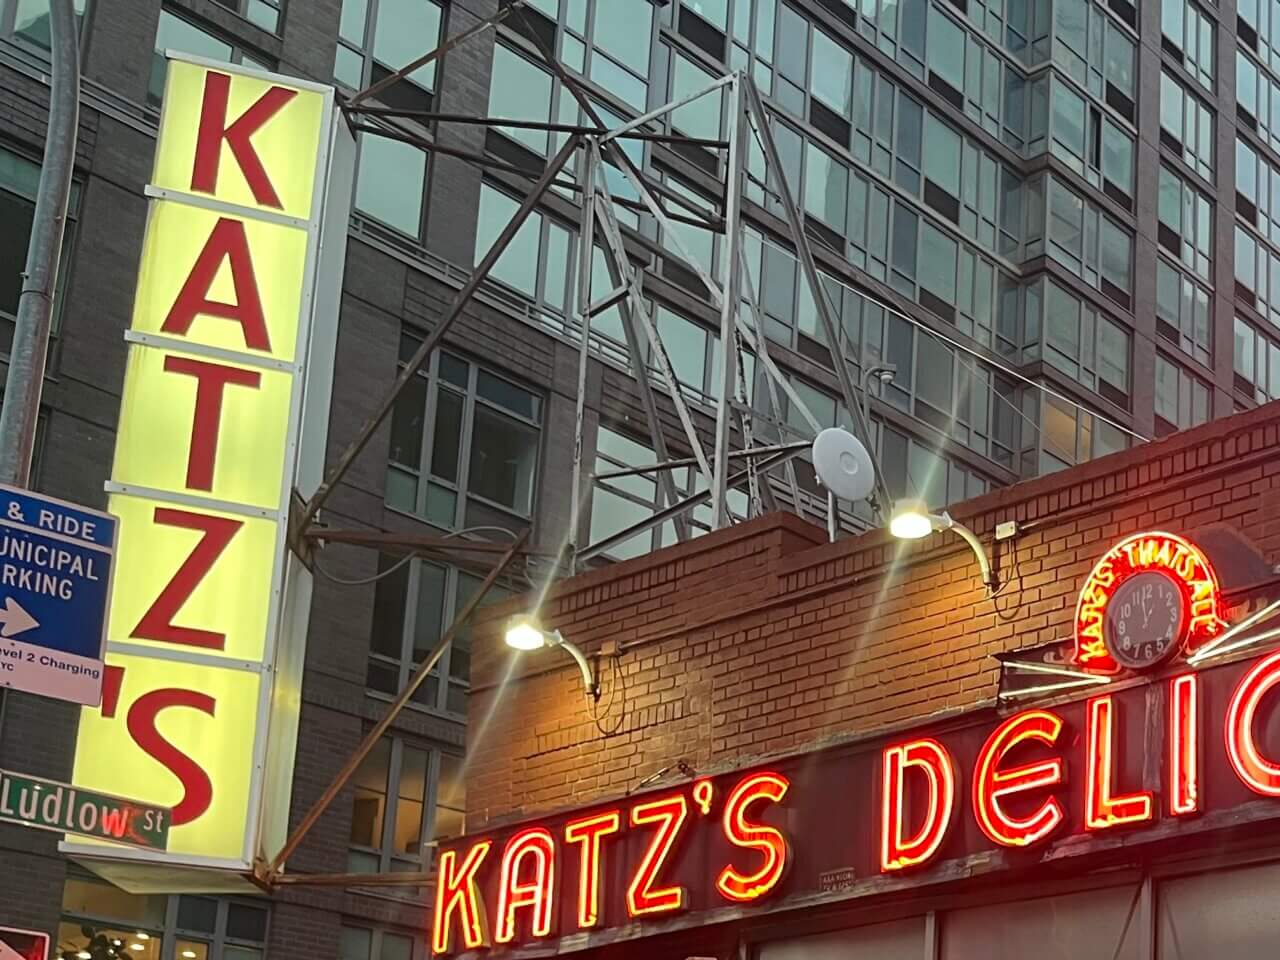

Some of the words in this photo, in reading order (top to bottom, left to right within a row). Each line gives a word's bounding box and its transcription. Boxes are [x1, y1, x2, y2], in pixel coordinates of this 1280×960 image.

[101, 70, 299, 827] KATZ'S
[8, 502, 24, 522] &
[39, 510, 97, 541] RIDE
[3, 564, 73, 600] RKING
[1132, 591, 1140, 606] 11
[1120, 603, 1131, 618] 10
[27, 653, 36, 662] 2
[40, 656, 100, 679] Charging
[1, 778, 129, 838] Ludlow
[143, 809, 163, 832] St
[432, 771, 793, 955] KATZ'S
